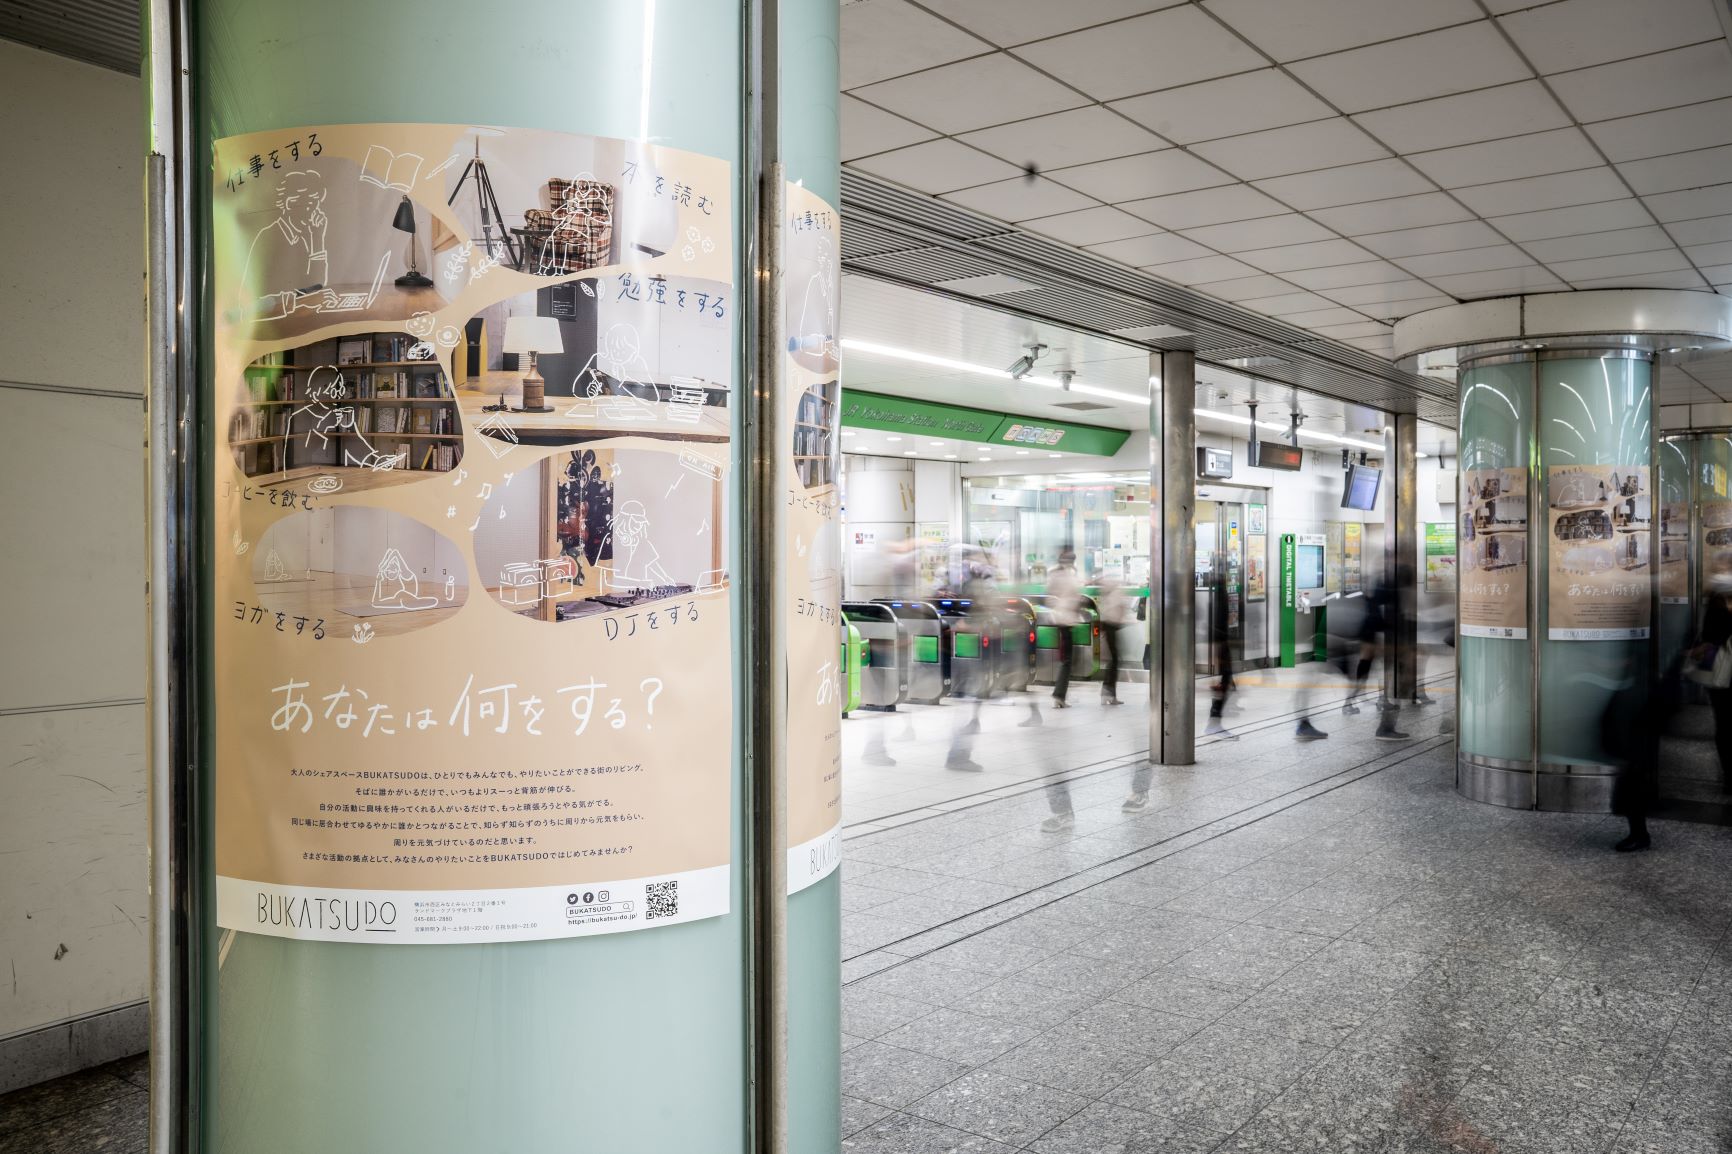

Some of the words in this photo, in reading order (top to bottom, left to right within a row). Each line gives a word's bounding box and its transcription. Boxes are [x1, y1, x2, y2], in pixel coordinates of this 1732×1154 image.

[226, 133, 323, 193] 仕事をする
[621, 161, 714, 216] 本を読む
[617, 272, 725, 319] 勉強をする
[234, 601, 325, 640] ヨガをする
[603, 601, 699, 641] DJをする
[258, 892, 397, 932] BUKATSUDO
[568, 912, 637, 925] https://bukatsu-do.jp/
[569, 905, 612, 915] BUKATSUDO
